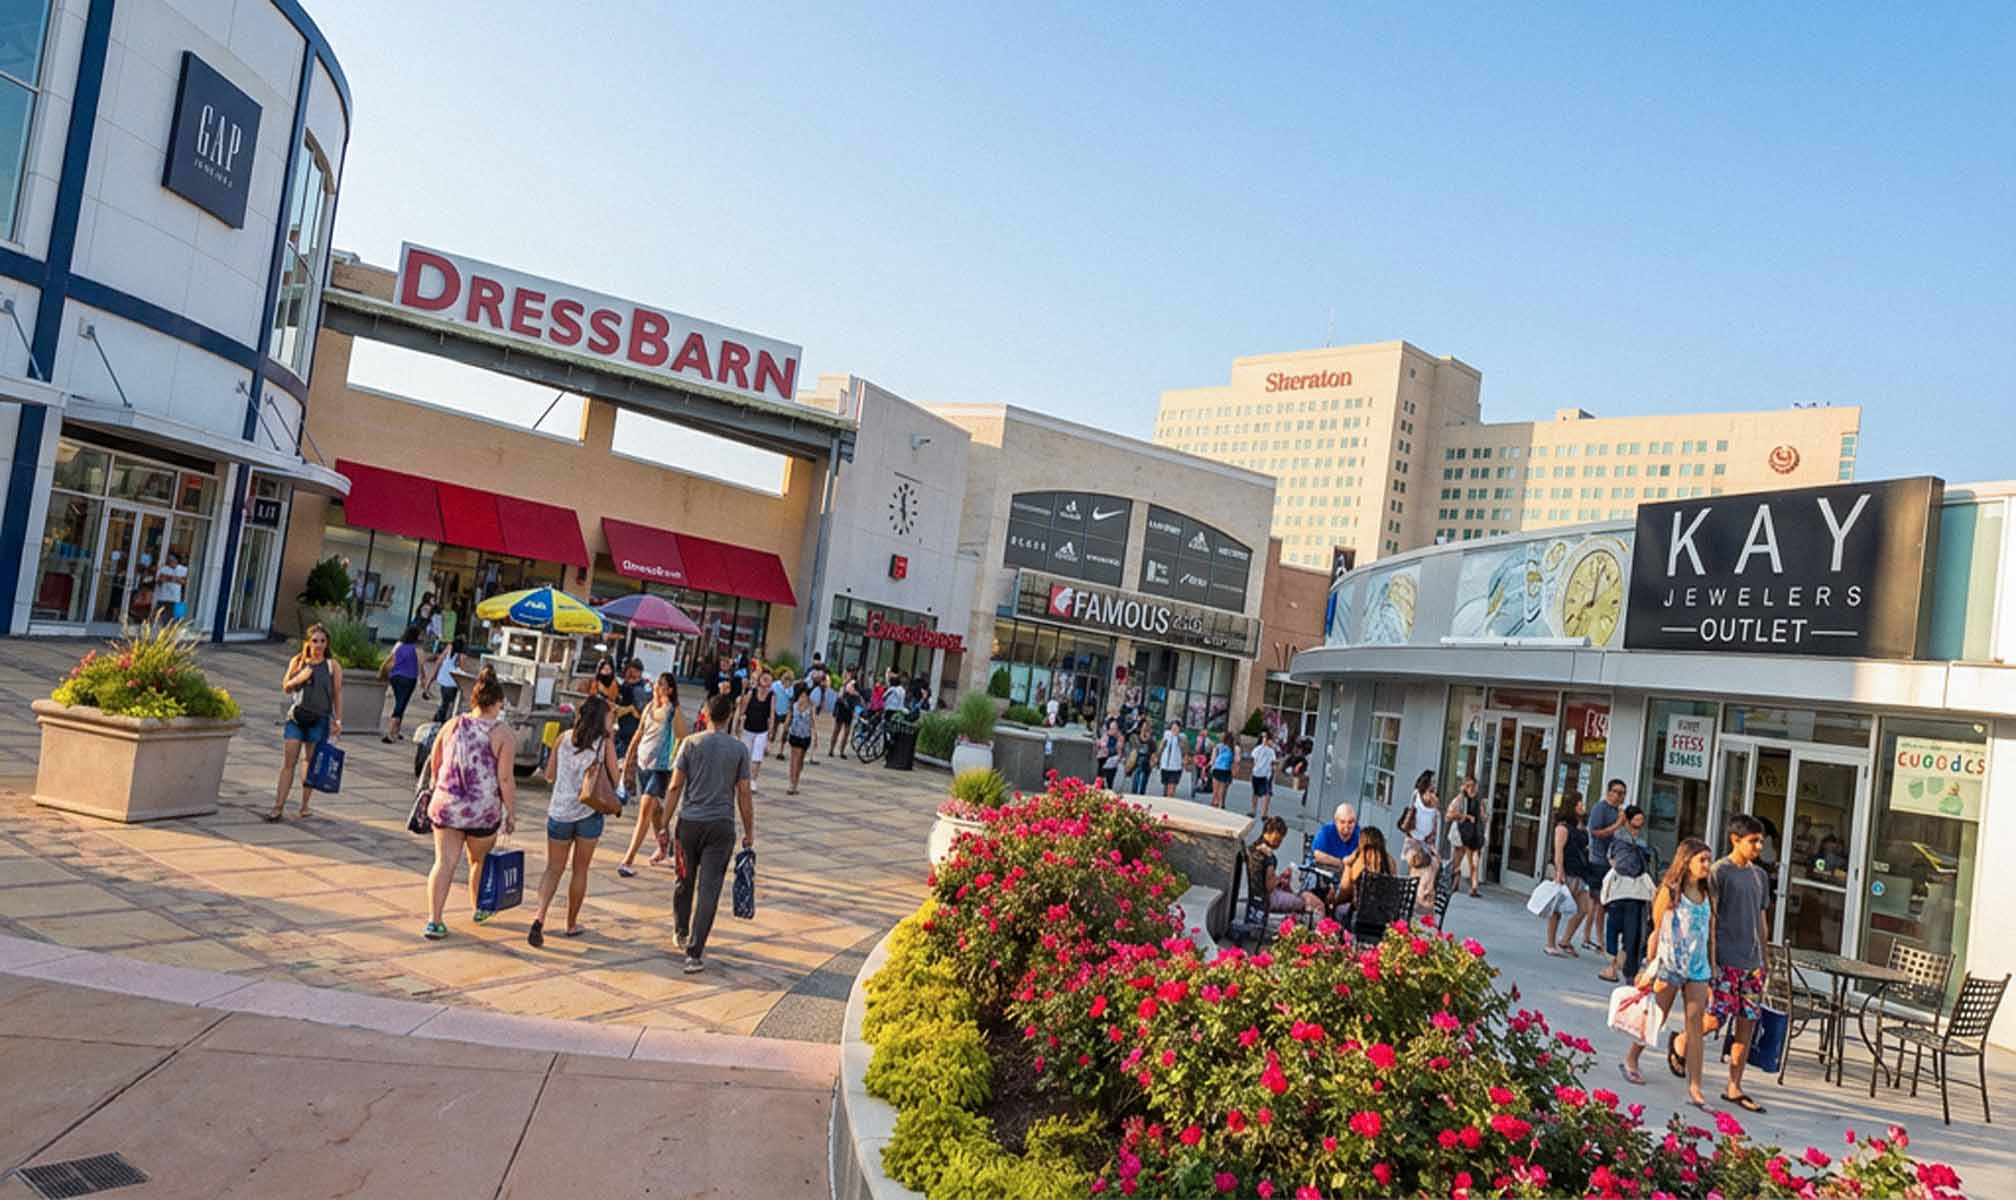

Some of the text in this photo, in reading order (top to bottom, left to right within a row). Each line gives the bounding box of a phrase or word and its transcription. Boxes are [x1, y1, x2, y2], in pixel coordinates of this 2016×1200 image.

[197, 104, 242, 172] GAP
[1265, 370, 1353, 392] Sheraton
[1666, 494, 1871, 577] KAY
[1072, 591, 1171, 634] FAMOUS
[1663, 585, 1863, 607] JEWELERS
[1699, 618, 1808, 644] OUTLET
